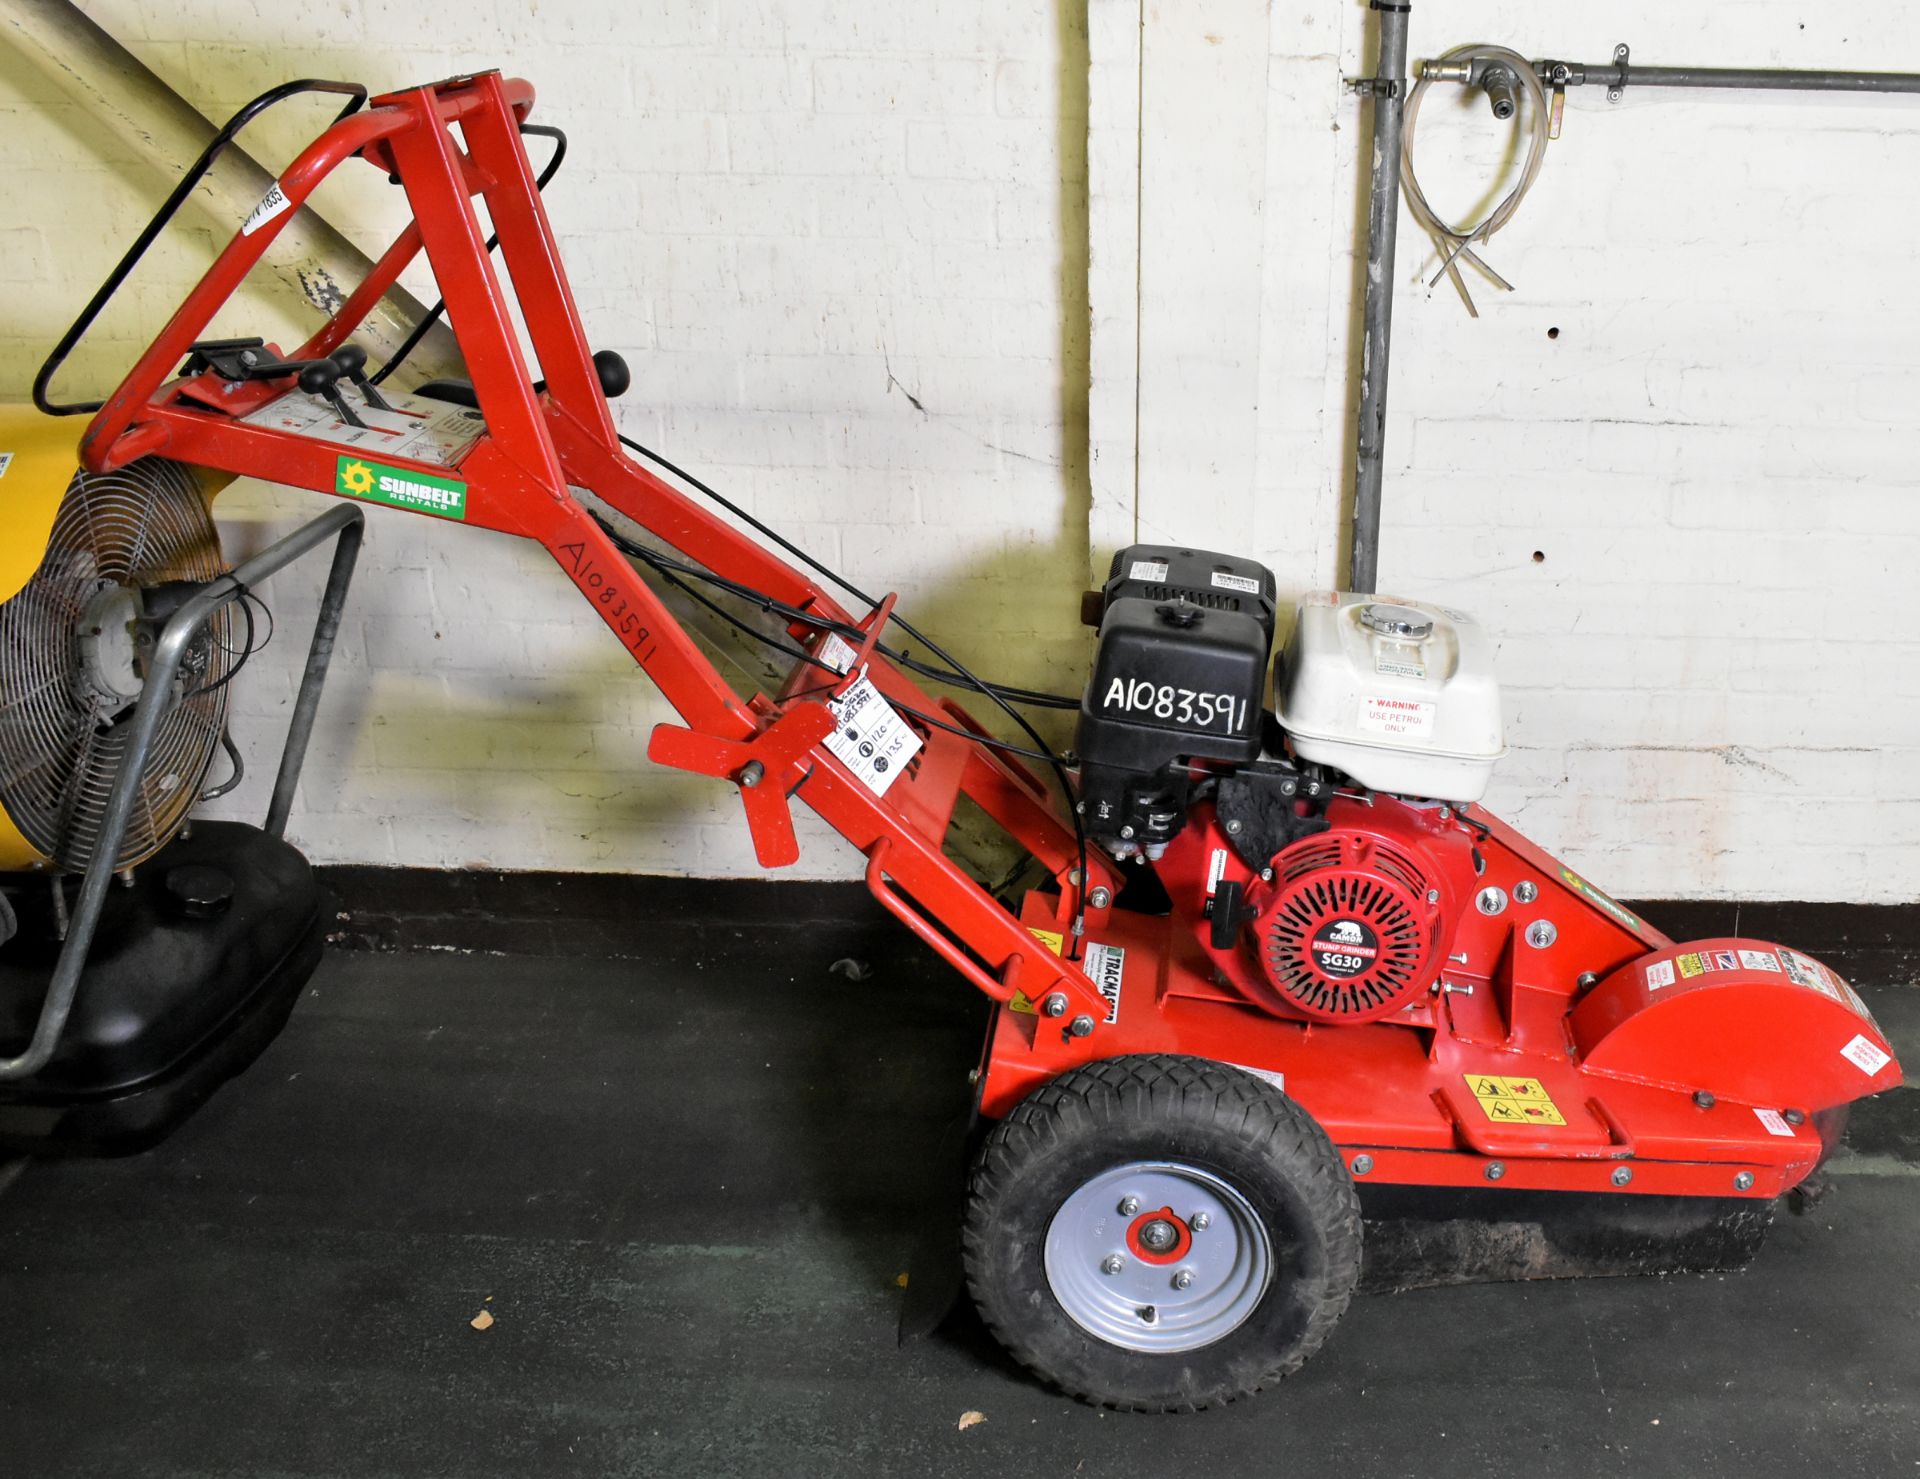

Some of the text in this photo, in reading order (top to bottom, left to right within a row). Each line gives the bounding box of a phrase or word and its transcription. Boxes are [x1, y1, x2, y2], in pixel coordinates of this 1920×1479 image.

[262, 187, 282, 210] 1835
[379, 475, 461, 507] SUNBELT
[389, 492, 448, 511] RENTALS
[558, 542, 657, 663] A1083591
[1103, 677, 1247, 735] A1083591
[1369, 711, 1387, 721] USE
[871, 725, 887, 742] 120
[1384, 723, 1407, 733] ONLY
[1329, 932, 1363, 943] CAMON
[1313, 941, 1340, 951] STUMP
[1341, 945, 1376, 956] GRINDER
[1321, 952, 1362, 969] SG30
